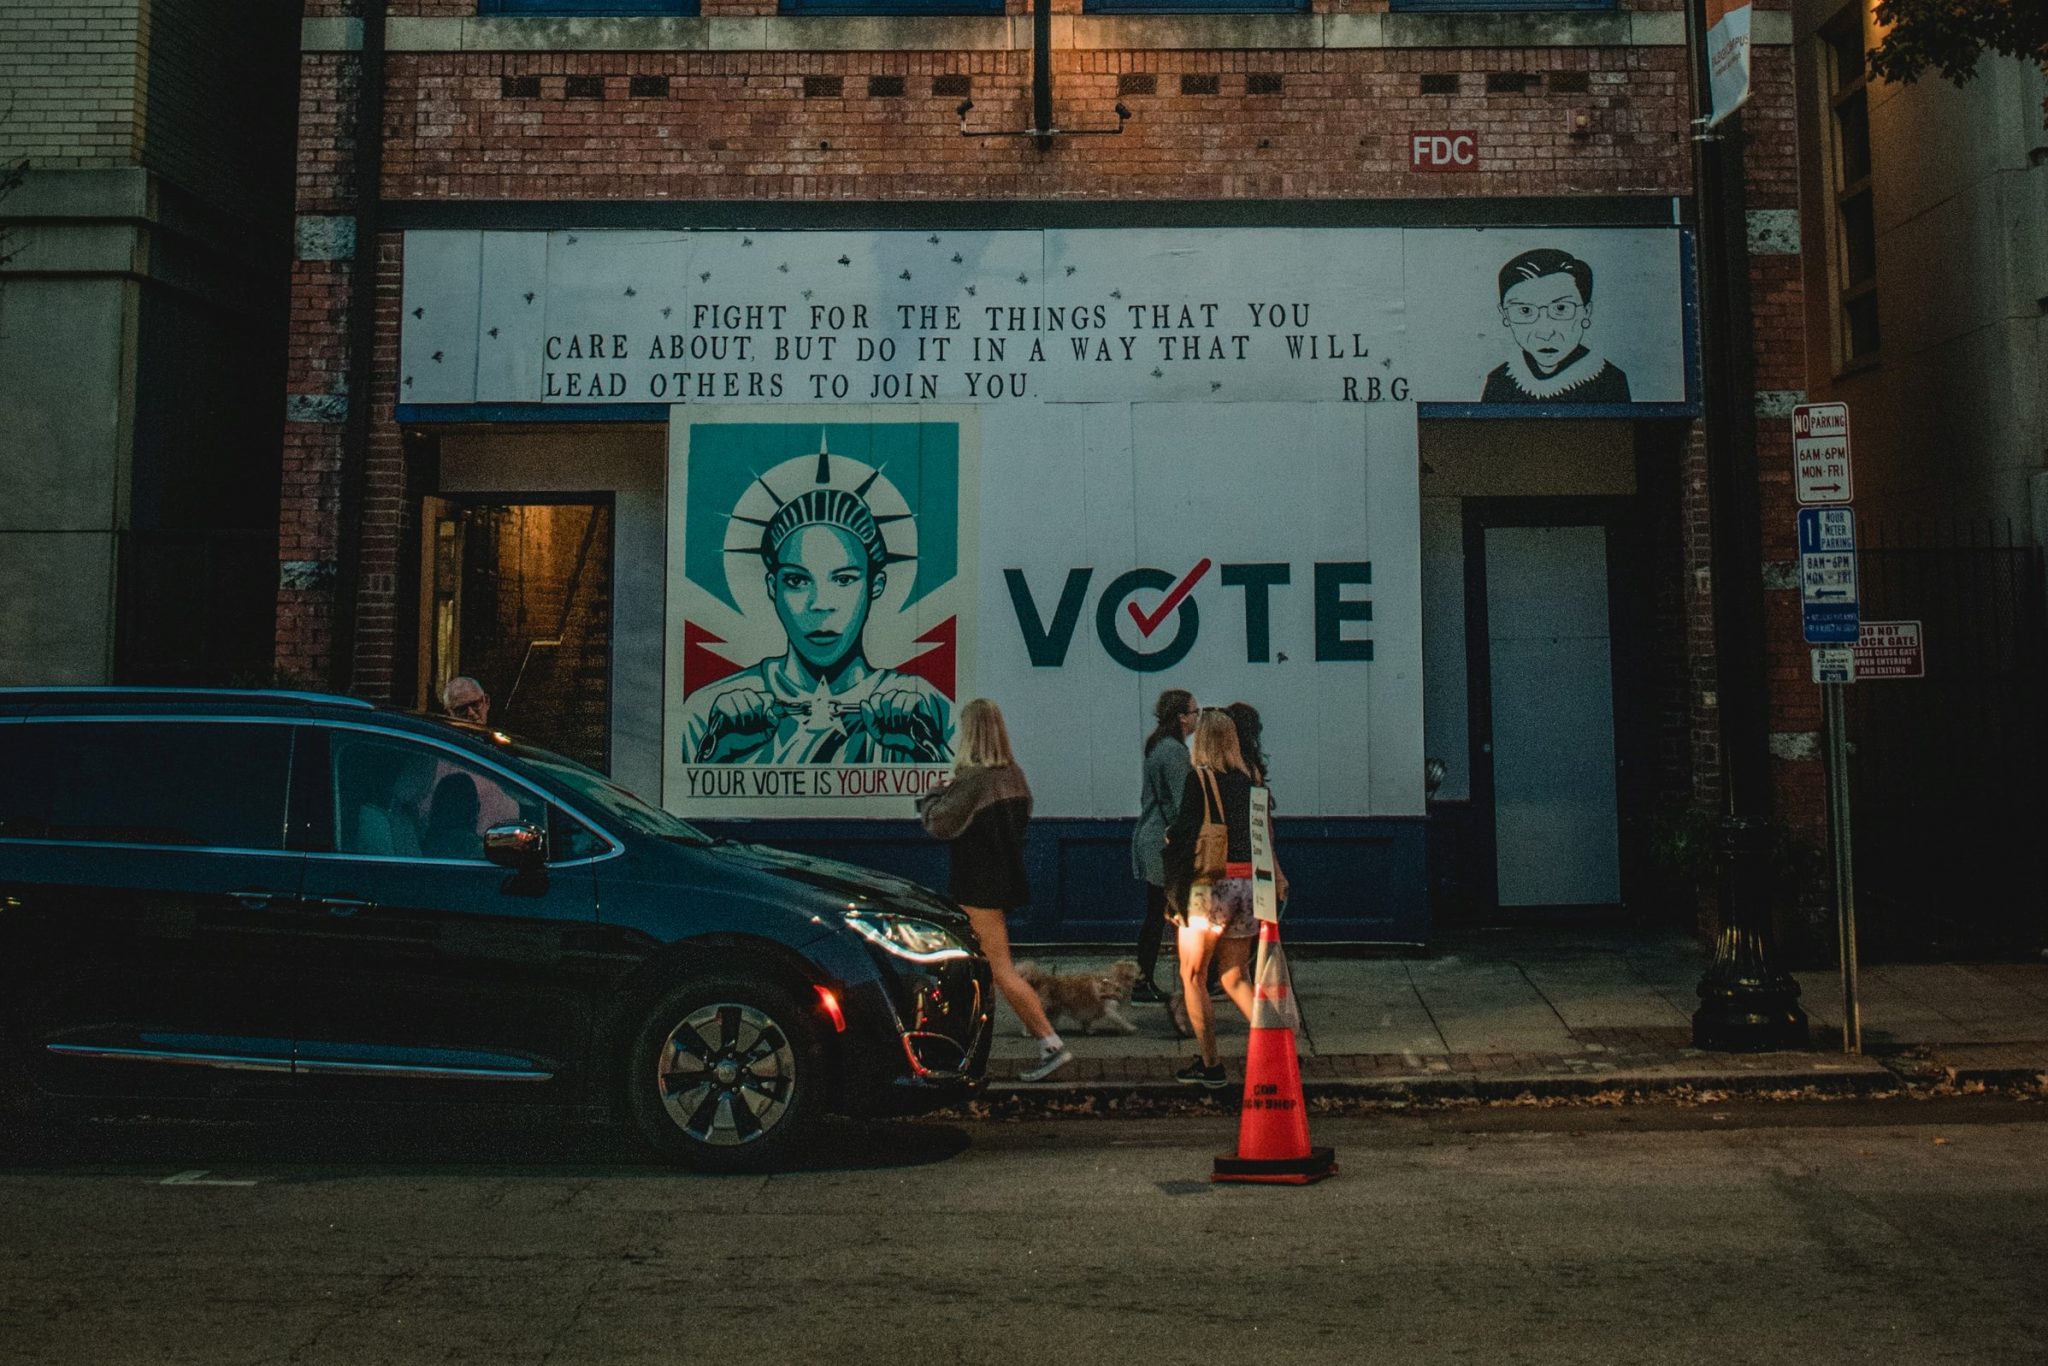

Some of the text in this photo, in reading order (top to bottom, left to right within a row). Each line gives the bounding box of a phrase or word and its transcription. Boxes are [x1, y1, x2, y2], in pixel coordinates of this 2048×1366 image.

[1413, 135, 1474, 165] FDC
[693, 302, 1311, 332] FIGHT FOR THE THINGS THAT YOU
[546, 333, 1369, 363] CARE ABOUT, BUT DO IT IN A WAY THAT WILL
[545, 371, 1038, 400] LEAD OTHERS TO JOIN YOU.
[1342, 376, 1413, 402] R.B.G.
[1795, 414, 1845, 433] NO PARKING
[1825, 511, 1844, 523] HOUR
[1825, 524, 1847, 536] METER
[1821, 537, 1852, 549] PARKING
[1806, 572, 1824, 585] MON
[1003, 558, 1374, 673] VOTE
[1878, 626, 1900, 636] NOT
[1888, 636, 1915, 646] GATE
[1899, 648, 1916, 656] GATE
[1876, 657, 1912, 666] ENTERING
[1860, 666, 1906, 675] AND EXITING
[687, 770, 744, 795] YOUR
[753, 770, 806, 795] VOTE
[813, 770, 832, 795] IS
[837, 769, 888, 795] YOUR
